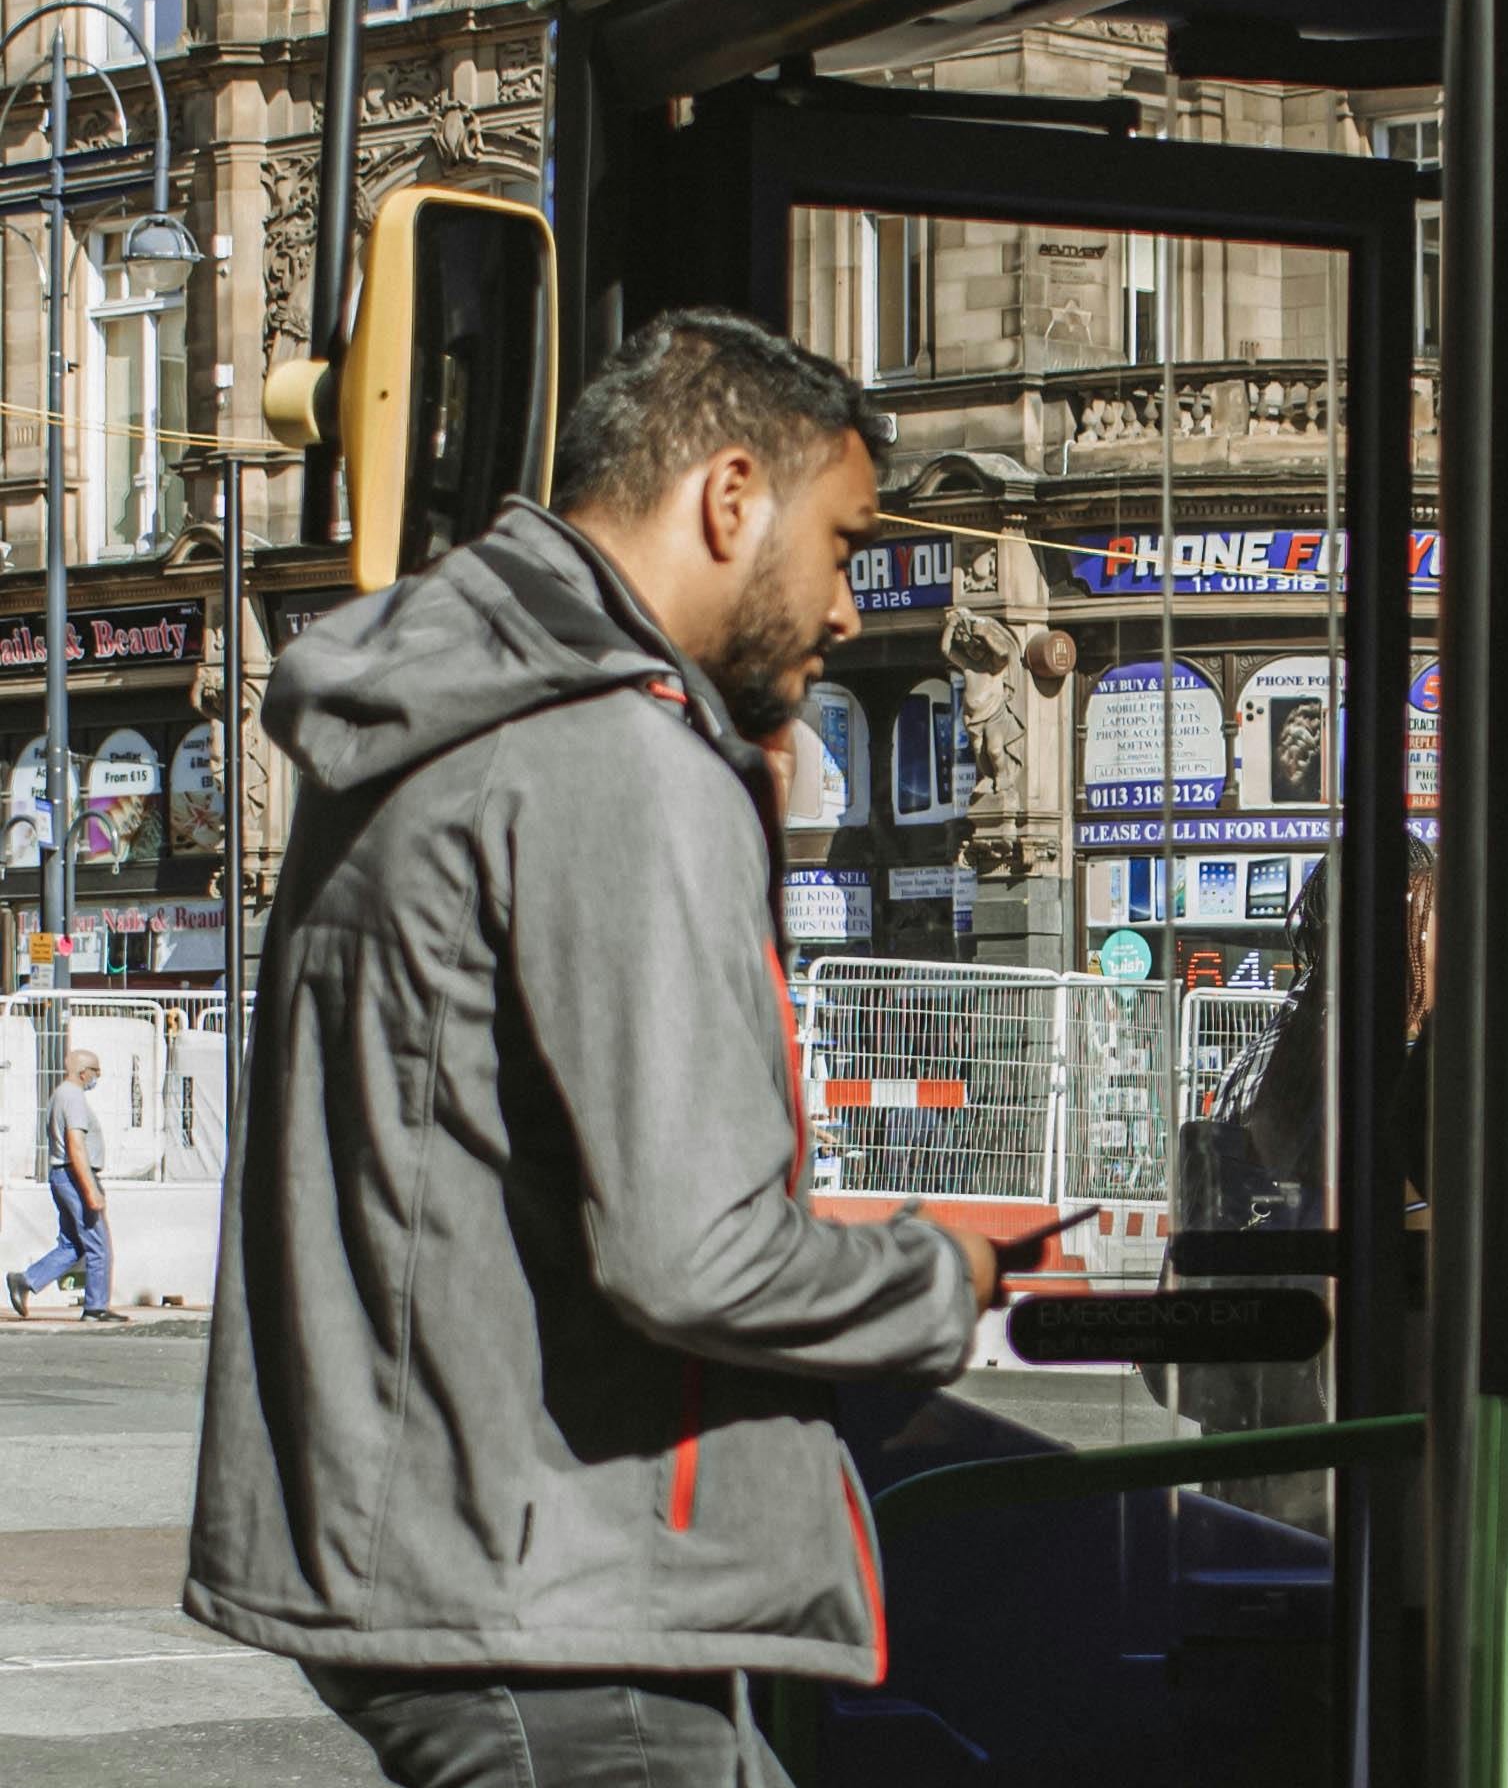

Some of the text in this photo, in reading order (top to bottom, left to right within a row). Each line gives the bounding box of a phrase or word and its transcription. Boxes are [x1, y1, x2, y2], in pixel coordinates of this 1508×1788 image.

[1106, 532, 1346, 576] PHONE FO
[851, 542, 952, 591] OR YOU
[1221, 576, 1269, 592] 0113
[1276, 575, 1318, 592] 318
[871, 591, 912, 608] 2126
[0, 625, 48, 665] ails
[91, 617, 188, 660] Beauty
[1098, 675, 1199, 693] WE BUY & ELL
[1256, 675, 1304, 687] PHONE
[1105, 701, 1196, 714] MOBILE PHNES
[1096, 726, 1211, 742] PHONE ACCEORIES
[105, 770, 147, 784] From £15
[1091, 783, 1216, 808] 0113 318 2126
[1080, 823, 1142, 844] PLEASE
[1200, 821, 1220, 840] IN
[1225, 820, 1264, 840] FOR
[791, 869, 869, 885] BUY & SELL
[807, 890, 840, 902] KIND
[103, 908, 147, 933] Nails
[151, 907, 168, 933] &
[175, 906, 226, 929] Beaut
[783, 905, 814, 917] OBILE
[1039, 1300, 1263, 1328] EMERGENCY EXIT
